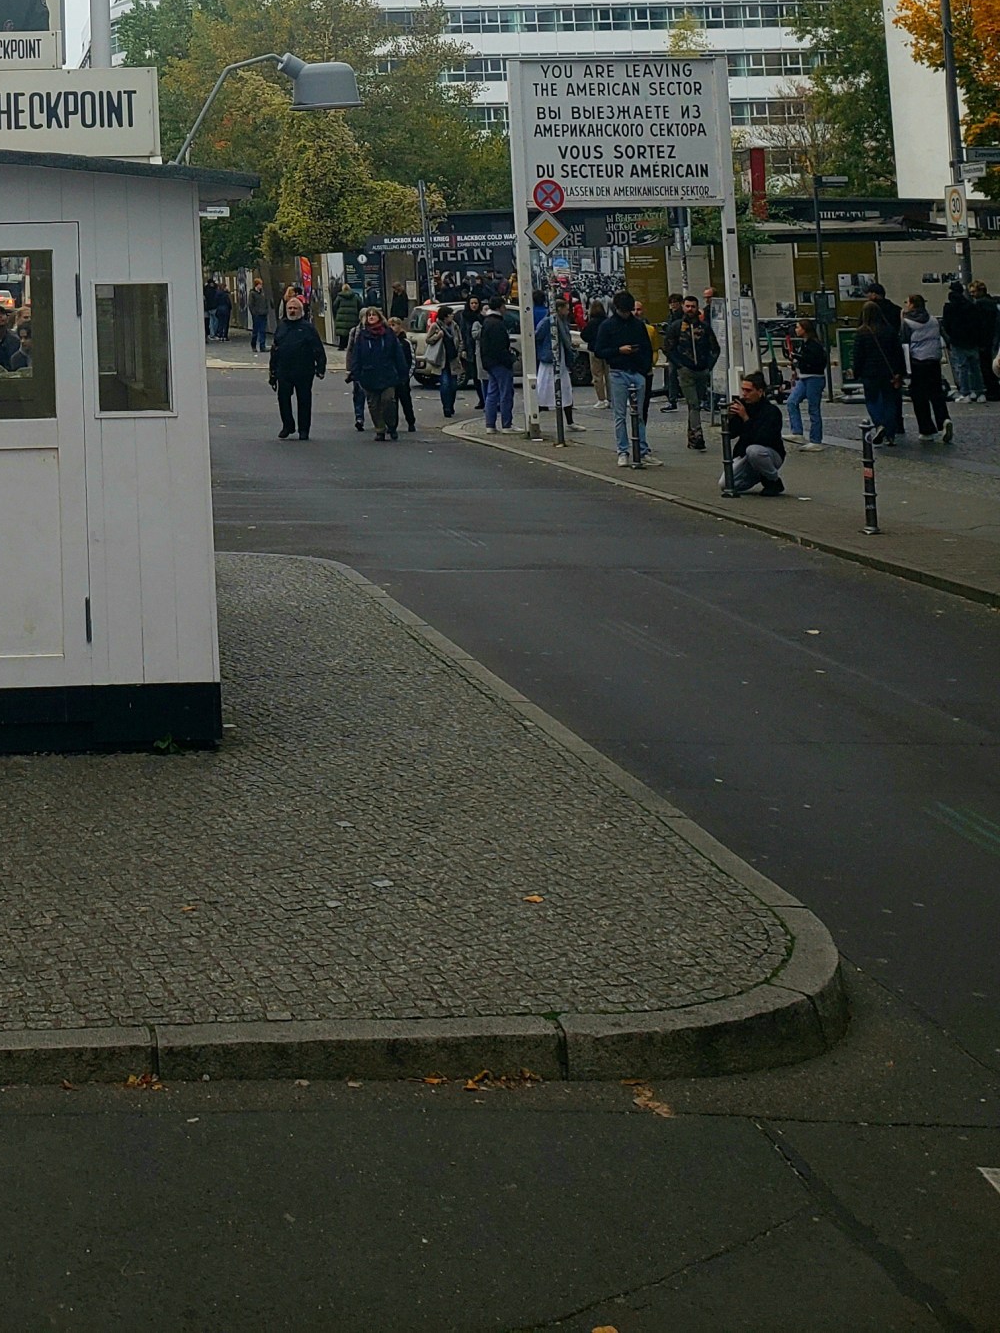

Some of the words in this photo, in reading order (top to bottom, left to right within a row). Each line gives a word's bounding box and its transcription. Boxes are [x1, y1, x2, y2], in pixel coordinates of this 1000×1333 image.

[540, 64, 573, 79] YOU
[584, 64, 615, 78] ARE
[625, 63, 693, 78] LEAVING
[533, 82, 558, 97] THE
[566, 82, 640, 97] AMERICAN
[649, 81, 702, 96] SECTOR
[536, 106, 561, 120] ВЫ
[571, 105, 670, 120] ВЫЕЗЖАЕТЕ
[680, 105, 701, 119] ИЗ
[534, 123, 644, 138] АМЕРИКАНСКОГО
[649, 123, 707, 137] СЕКТОРА
[558, 145, 604, 160] VOUS
[613, 144, 677, 160] SORTEZ
[536, 164, 555, 179] DU
[560, 163, 624, 179] SECTEUR
[630, 160, 709, 179] AMÉRICAIN
[596, 186, 611, 197] DEN
[613, 185, 679, 197] AMERIKANISCHEN
[681, 185, 709, 197] SEKTOR
[951, 197, 961, 214] 30
